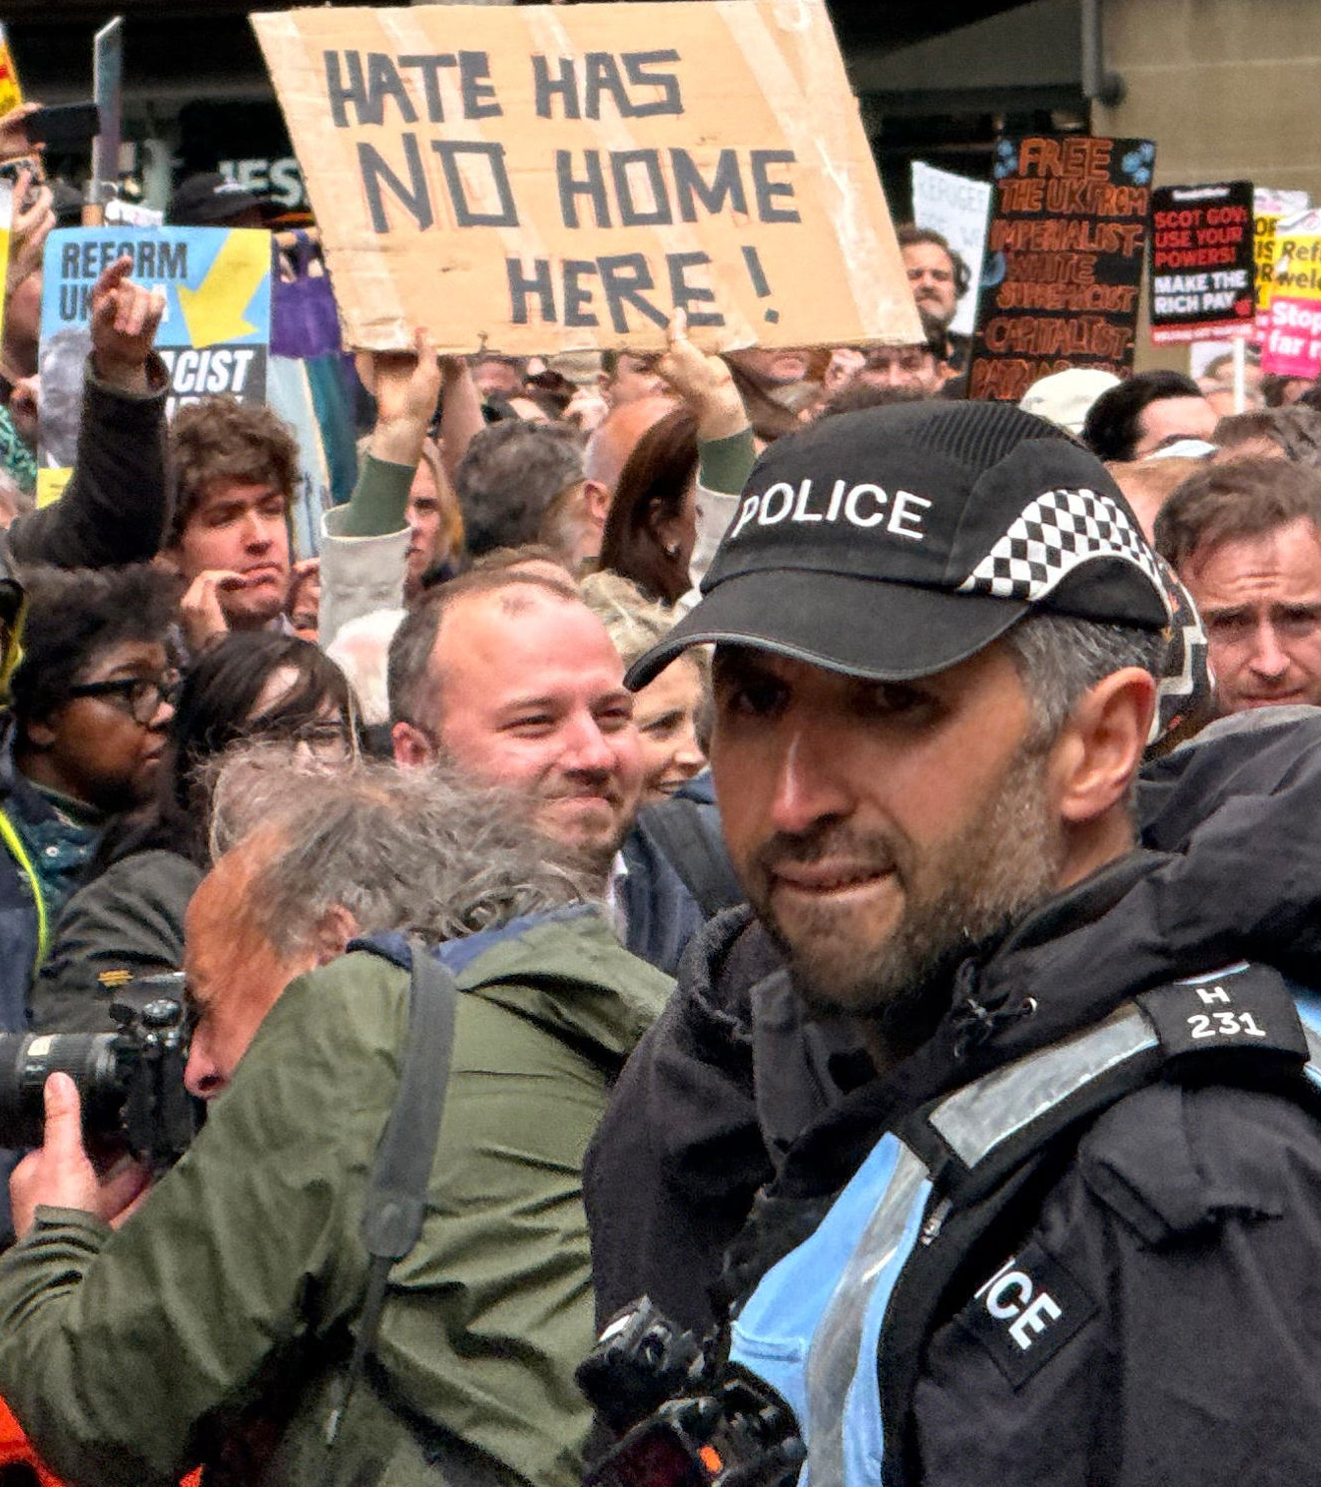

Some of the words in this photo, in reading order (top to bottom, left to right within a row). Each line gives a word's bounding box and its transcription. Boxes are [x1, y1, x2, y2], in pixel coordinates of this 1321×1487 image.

[322, 49, 503, 127] HATE
[531, 48, 684, 119] HAS
[1018, 137, 1114, 181] FREE
[357, 132, 521, 233] NO
[555, 148, 802, 228] HOME
[999, 178, 1046, 213] THE
[1046, 179, 1088, 213] UK
[1087, 183, 1149, 216] FROM
[1154, 210, 1203, 229] SCOT
[1155, 230, 1192, 248] USE
[1196, 226, 1243, 244] YOUR
[1154, 247, 1236, 268] POWERS!
[1154, 274, 1209, 293] MAKE
[1212, 269, 1248, 288] THE
[1154, 295, 1201, 314] RICH
[1202, 292, 1236, 311] PAY
[1268, 331, 1305, 357] far
[729, 478, 933, 540] POLICE
[1196, 985, 1230, 1004] H
[1186, 1011, 1267, 1039] 231
